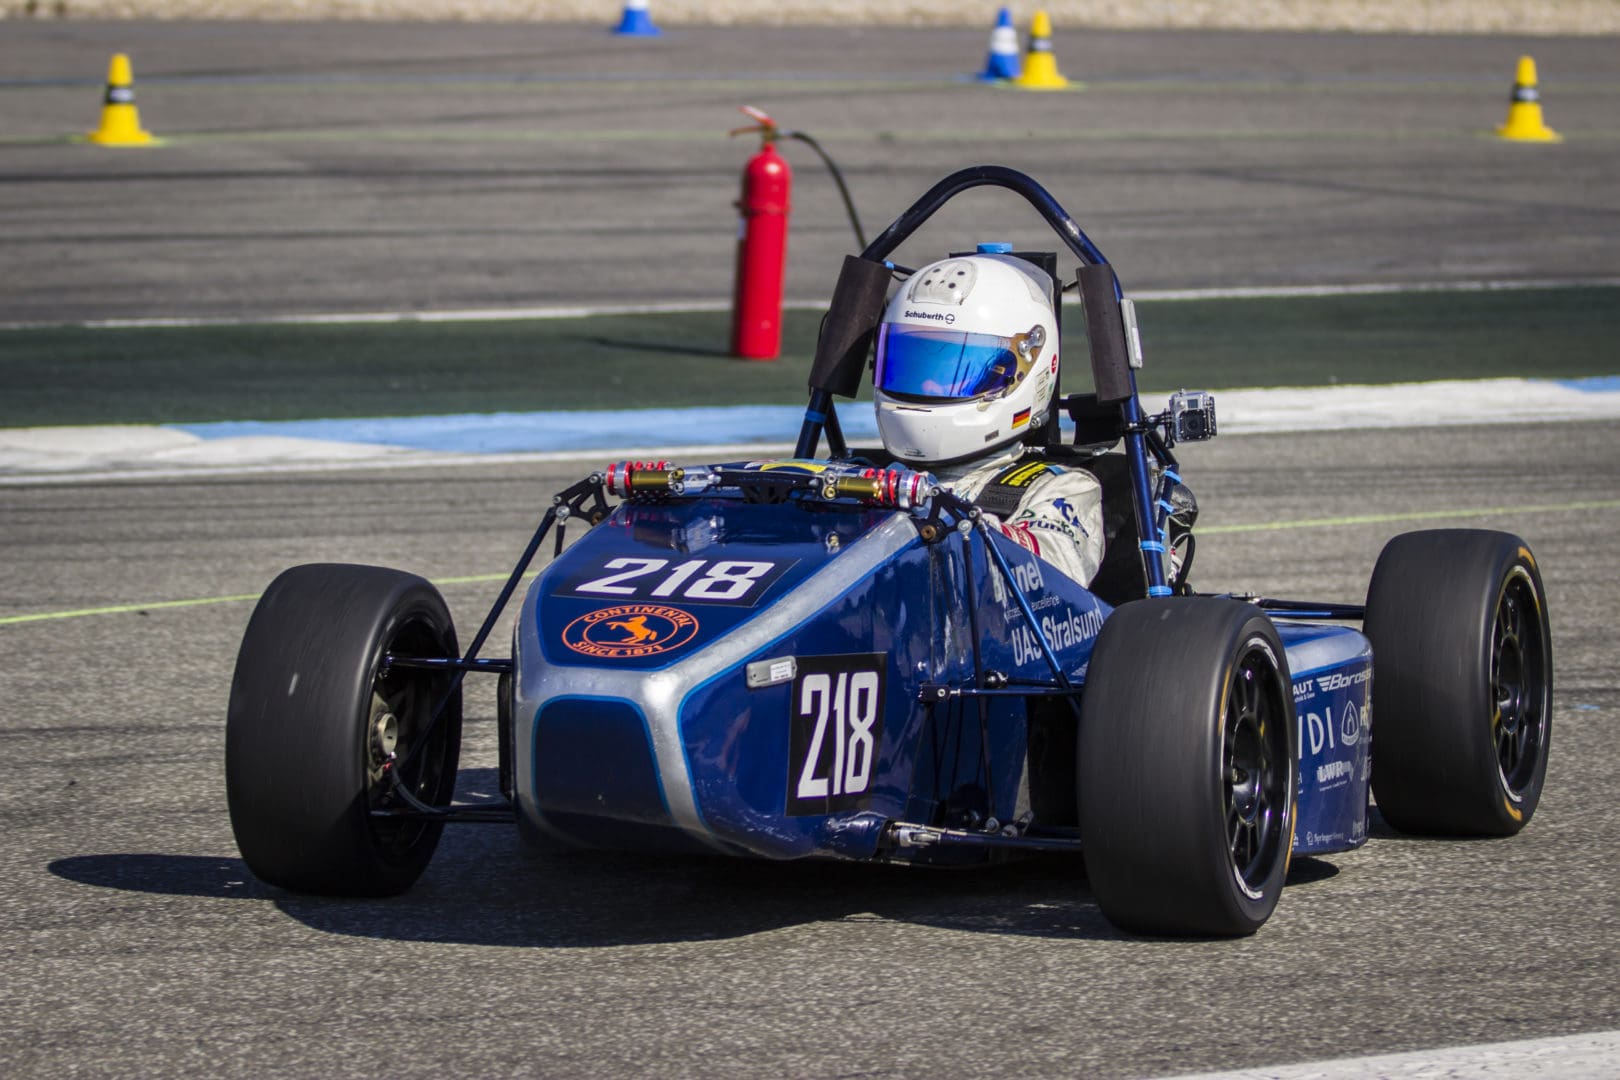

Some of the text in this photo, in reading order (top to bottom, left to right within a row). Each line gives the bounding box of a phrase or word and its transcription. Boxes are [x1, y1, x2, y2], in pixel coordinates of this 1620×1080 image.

[904, 310, 944, 321] Schuberth
[574, 557, 776, 600] 218
[583, 605, 694, 628] CONTINENTAL
[1042, 597, 1104, 652] Stralsund
[572, 640, 664, 657] SINCE 1871
[796, 670, 879, 799] 218
